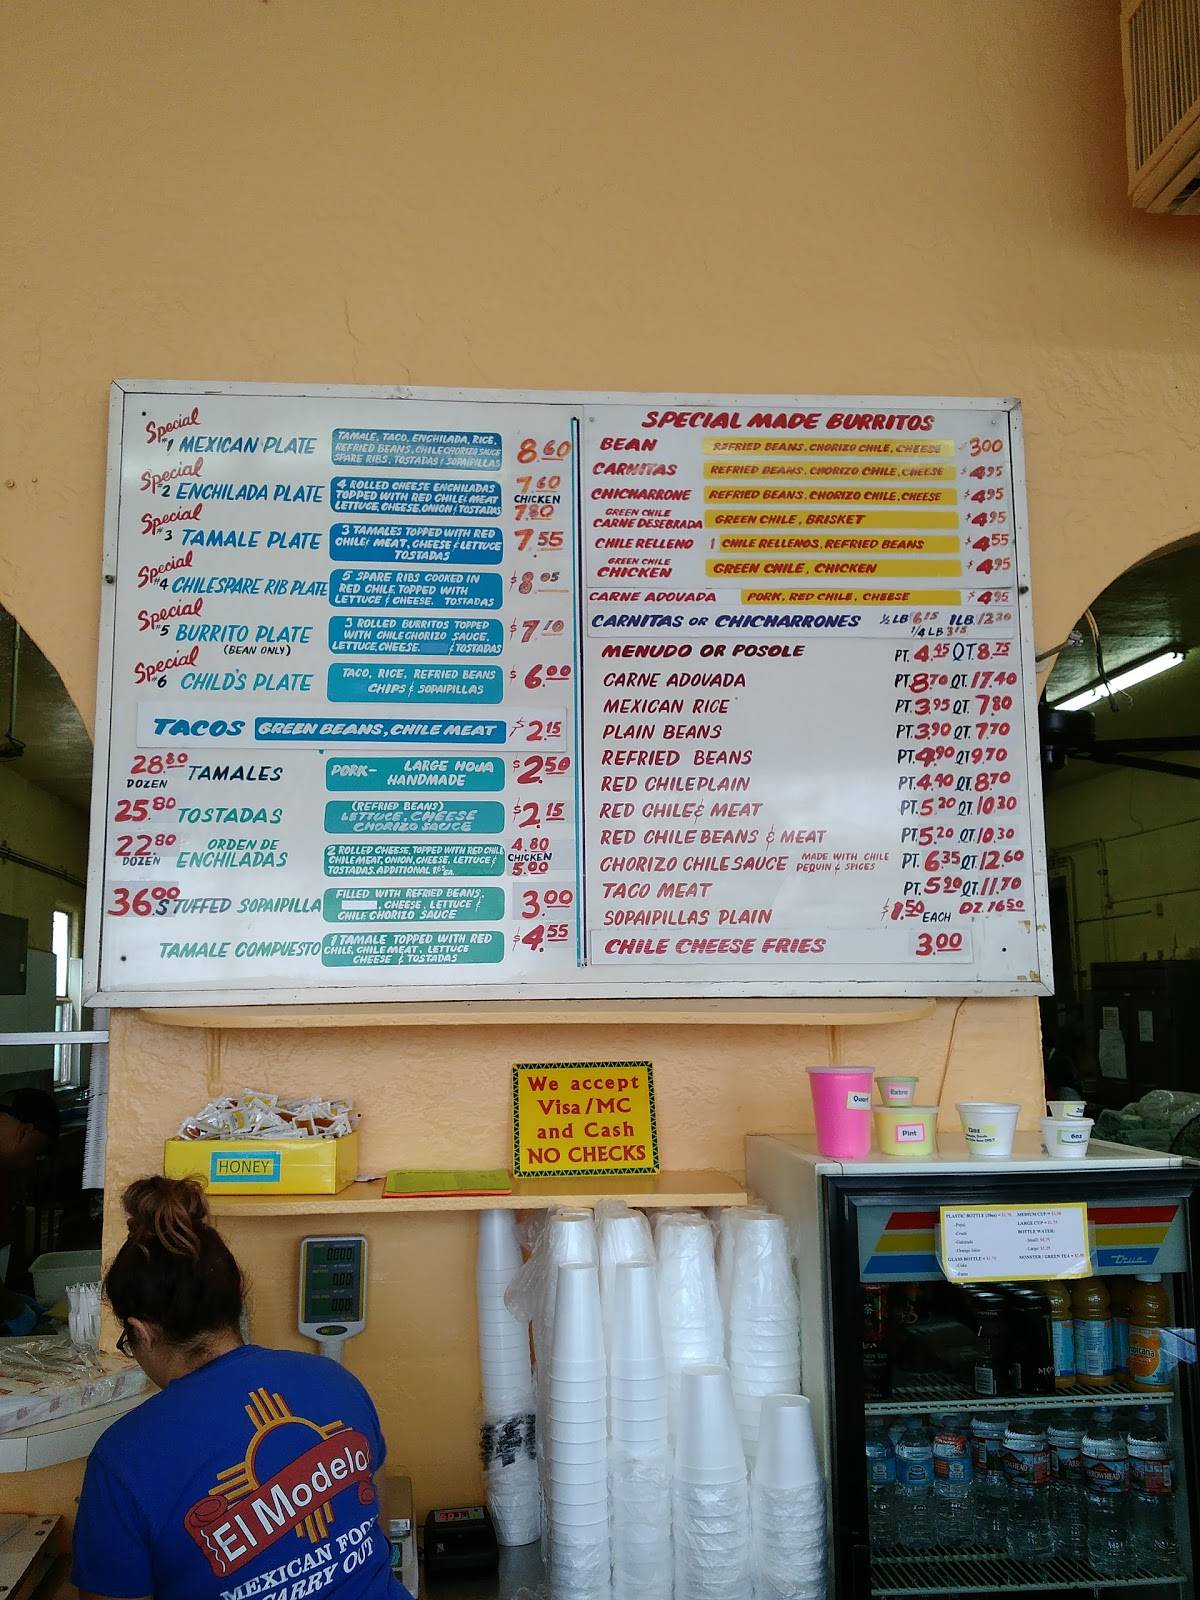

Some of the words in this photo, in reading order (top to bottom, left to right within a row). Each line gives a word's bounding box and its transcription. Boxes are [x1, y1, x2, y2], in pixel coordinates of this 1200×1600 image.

[145, 407, 201, 444] Special
[642, 411, 741, 429] SPECIAL
[747, 412, 822, 430] MADE
[826, 413, 935, 431] BURRITOS
[179, 436, 259, 453] MEXICAN
[263, 437, 317, 454] PLATE
[600, 438, 657, 451] BEAN
[140, 457, 204, 495] Special
[592, 463, 677, 476] CARNITAS
[176, 482, 268, 500] ENCHILADA
[273, 484, 325, 502] PLATE
[337, 479, 346, 489] 4
[350, 480, 389, 490] ROLLED
[392, 481, 430, 491] CHEESE
[433, 482, 495, 493] ENCHILADAS
[335, 490, 377, 500] TOPPED
[380, 491, 408, 501] WITH
[411, 492, 432, 502] RED
[513, 494, 561, 504] CHICKEN
[591, 488, 692, 501] CHICHARRONE
[709, 489, 760, 500] REFRIED
[141, 503, 203, 535] Special
[605, 508, 639, 517] GREEN
[642, 508, 671, 518] CHILE
[805, 514, 866, 525] BRISKET
[342, 525, 350, 535] 3
[353, 525, 402, 536] TAMALES
[405, 526, 442, 537] TOPPED
[444, 527, 471, 538] WITH
[473, 528, 495, 538] RED
[593, 518, 635, 529] CARNE
[637, 519, 703, 530] DESEBRADA
[181, 529, 262, 548] TAMALE
[267, 532, 322, 550] PLATE
[595, 538, 633, 549] CHILE
[636, 538, 694, 550] RELLENO
[824, 538, 877, 549] REFRIED
[881, 539, 925, 550] BEANS
[395, 550, 450, 561] TOSTADAS
[608, 557, 640, 566] GREEN
[642, 558, 671, 567] CHILE
[138, 550, 193, 588] Special
[597, 567, 672, 579] CHICKEN
[342, 571, 352, 581] 5
[355, 571, 391, 582] SPARE
[396, 572, 420, 583] RIBS
[424, 573, 463, 584] COOKED
[466, 574, 480, 584] IN
[138, 597, 204, 632] Special
[591, 614, 684, 628] CARNITAS
[715, 614, 862, 629] CHICHARRONES
[345, 617, 353, 628] 3
[357, 618, 397, 629] ROLLED
[402, 619, 449, 630] BURRITOS
[454, 620, 490, 630] TOPPED
[175, 624, 249, 642] BURRITO
[255, 626, 313, 644] PLATE
[224, 645, 257, 655] (BEAN
[261, 644, 291, 656] ONLY)
[601, 644, 693, 658] MENUDO
[699, 644, 726, 658] OR
[732, 645, 805, 657] POSOLE
[134, 645, 200, 684] Special
[181, 669, 247, 691] CHILD'S
[253, 673, 314, 691] PLATE
[413, 668, 459, 680] REFRIED
[462, 669, 496, 680] BEANS
[603, 672, 661, 688] CARNE
[666, 673, 746, 687] ADOVADA
[367, 683, 406, 693] CHIPS
[603, 699, 684, 714] MEXICAN
[692, 699, 730, 714] RICE
[153, 718, 246, 737] TACOS
[258, 722, 318, 735] GREEN
[602, 724, 656, 739] PLAIN
[662, 725, 722, 739] BEANS
[601, 750, 681, 766] REFRIED
[693, 750, 753, 766] BEANS
[188, 765, 283, 781] TAMALES
[404, 760, 448, 772] LARGE
[126, 779, 167, 789] DOZEN
[387, 774, 466, 787] HANDMADE
[601, 776, 638, 792] RED
[644, 776, 696, 792] CHILE
[697, 777, 751, 792] PLAIN
[178, 808, 282, 824] TOSTADAS
[207, 839, 257, 850] ORDEN
[262, 839, 280, 850] DE
[600, 829, 636, 846] RED
[643, 829, 698, 845] CHILE
[700, 829, 759, 845] BEANS
[122, 856, 160, 866] DOZEN
[176, 851, 288, 868] ENCHILADAS
[508, 853, 552, 862] CHICKEN
[600, 856, 678, 872] CHORIZO
[683, 856, 730, 872] CHILE
[731, 856, 789, 871] SAUCE
[801, 853, 828, 861] MADE
[833, 852, 858, 861] WITH
[863, 852, 889, 861] CHILE
[602, 882, 650, 899] TACO
[656, 882, 713, 899] MEAT
[603, 909, 710, 926] SOPAIPILLAS
[718, 909, 773, 926] PLAIN
[922, 912, 951, 923] EACH
[160, 942, 231, 959] TAMALE
[235, 941, 321, 957] COMPUESTO
[604, 938, 670, 954] CHILE
[675, 938, 754, 954] CHEESE
[761, 938, 827, 954] FRIES
[528, 1076, 558, 1092] We
[571, 1075, 639, 1092] accept
[537, 1123, 573, 1139] and
[584, 1121, 634, 1138] Cash
[902, 1129, 917, 1137] Pint
[528, 1147, 561, 1164] NO
[568, 1145, 646, 1163] CHECKS
[219, 1160, 269, 1174] HONEY
[212, 1514, 258, 1563] El
[251, 1447, 369, 1535] Modelo
[343, 1536, 374, 1574] OUT
